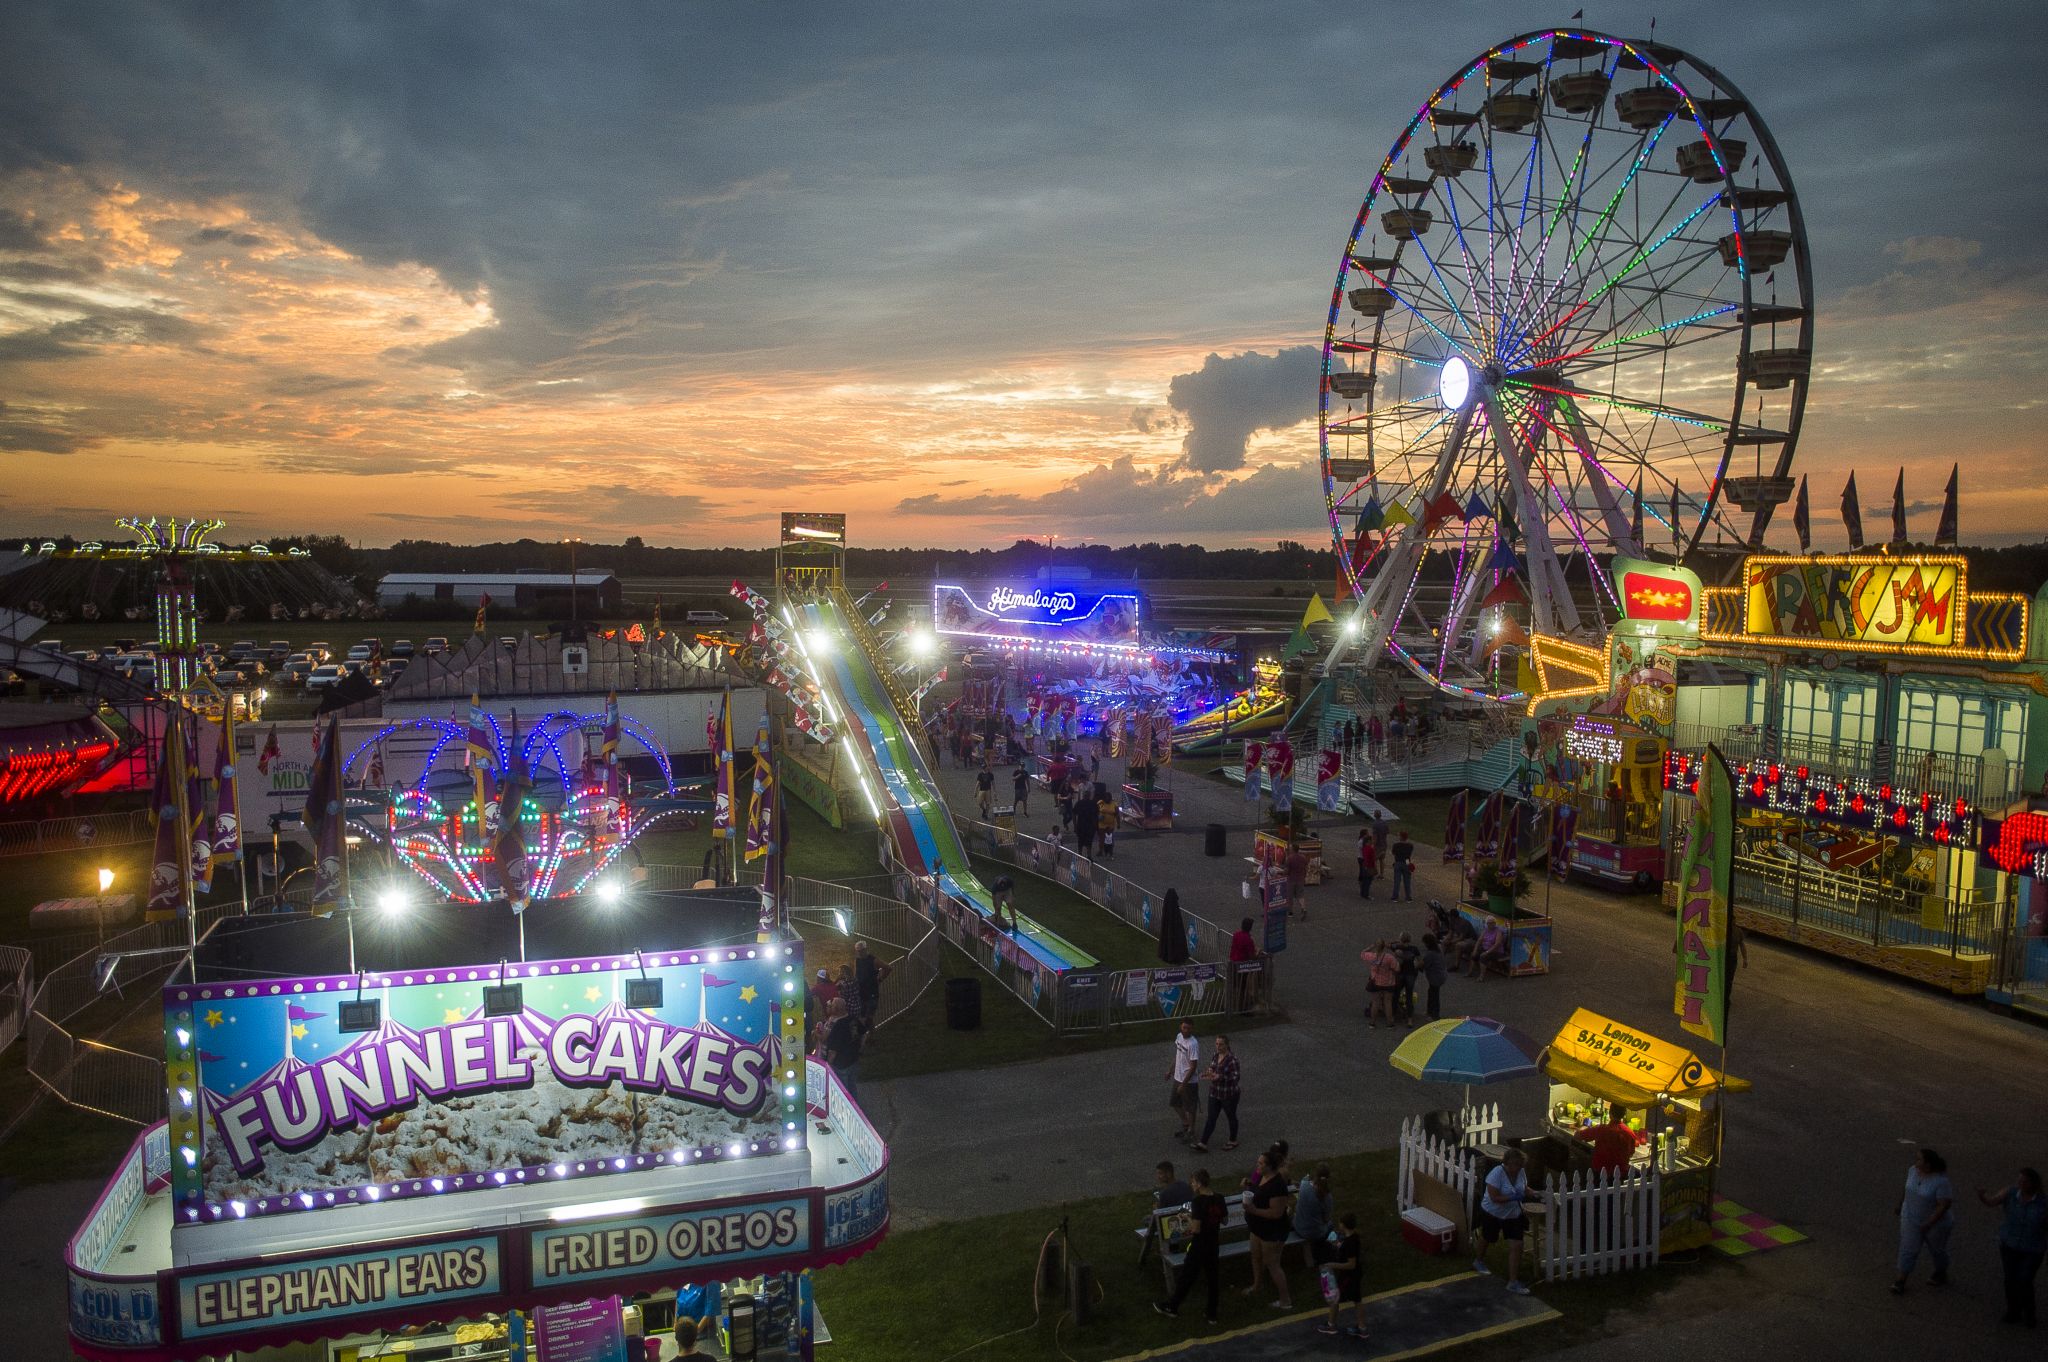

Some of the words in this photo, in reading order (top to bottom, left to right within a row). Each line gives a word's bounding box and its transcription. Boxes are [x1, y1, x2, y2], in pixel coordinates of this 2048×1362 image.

[988, 587, 1076, 615] Himalaya
[1750, 565, 1875, 637] TRAFFIC
[1875, 565, 1953, 636] JAM
[273, 761, 301, 772] NORTH
[1577, 1029, 1623, 1057] Shake
[1628, 1053, 1656, 1073] Ups
[1602, 1022, 1652, 1053] Lemon
[217, 1017, 530, 1171] FUNNEL
[550, 1014, 767, 1108] CAKES
[545, 1225, 657, 1277] FRIED
[666, 1206, 797, 1261] OREOS
[197, 1259, 390, 1328] ELEPHANT
[398, 1247, 487, 1297] EARS
